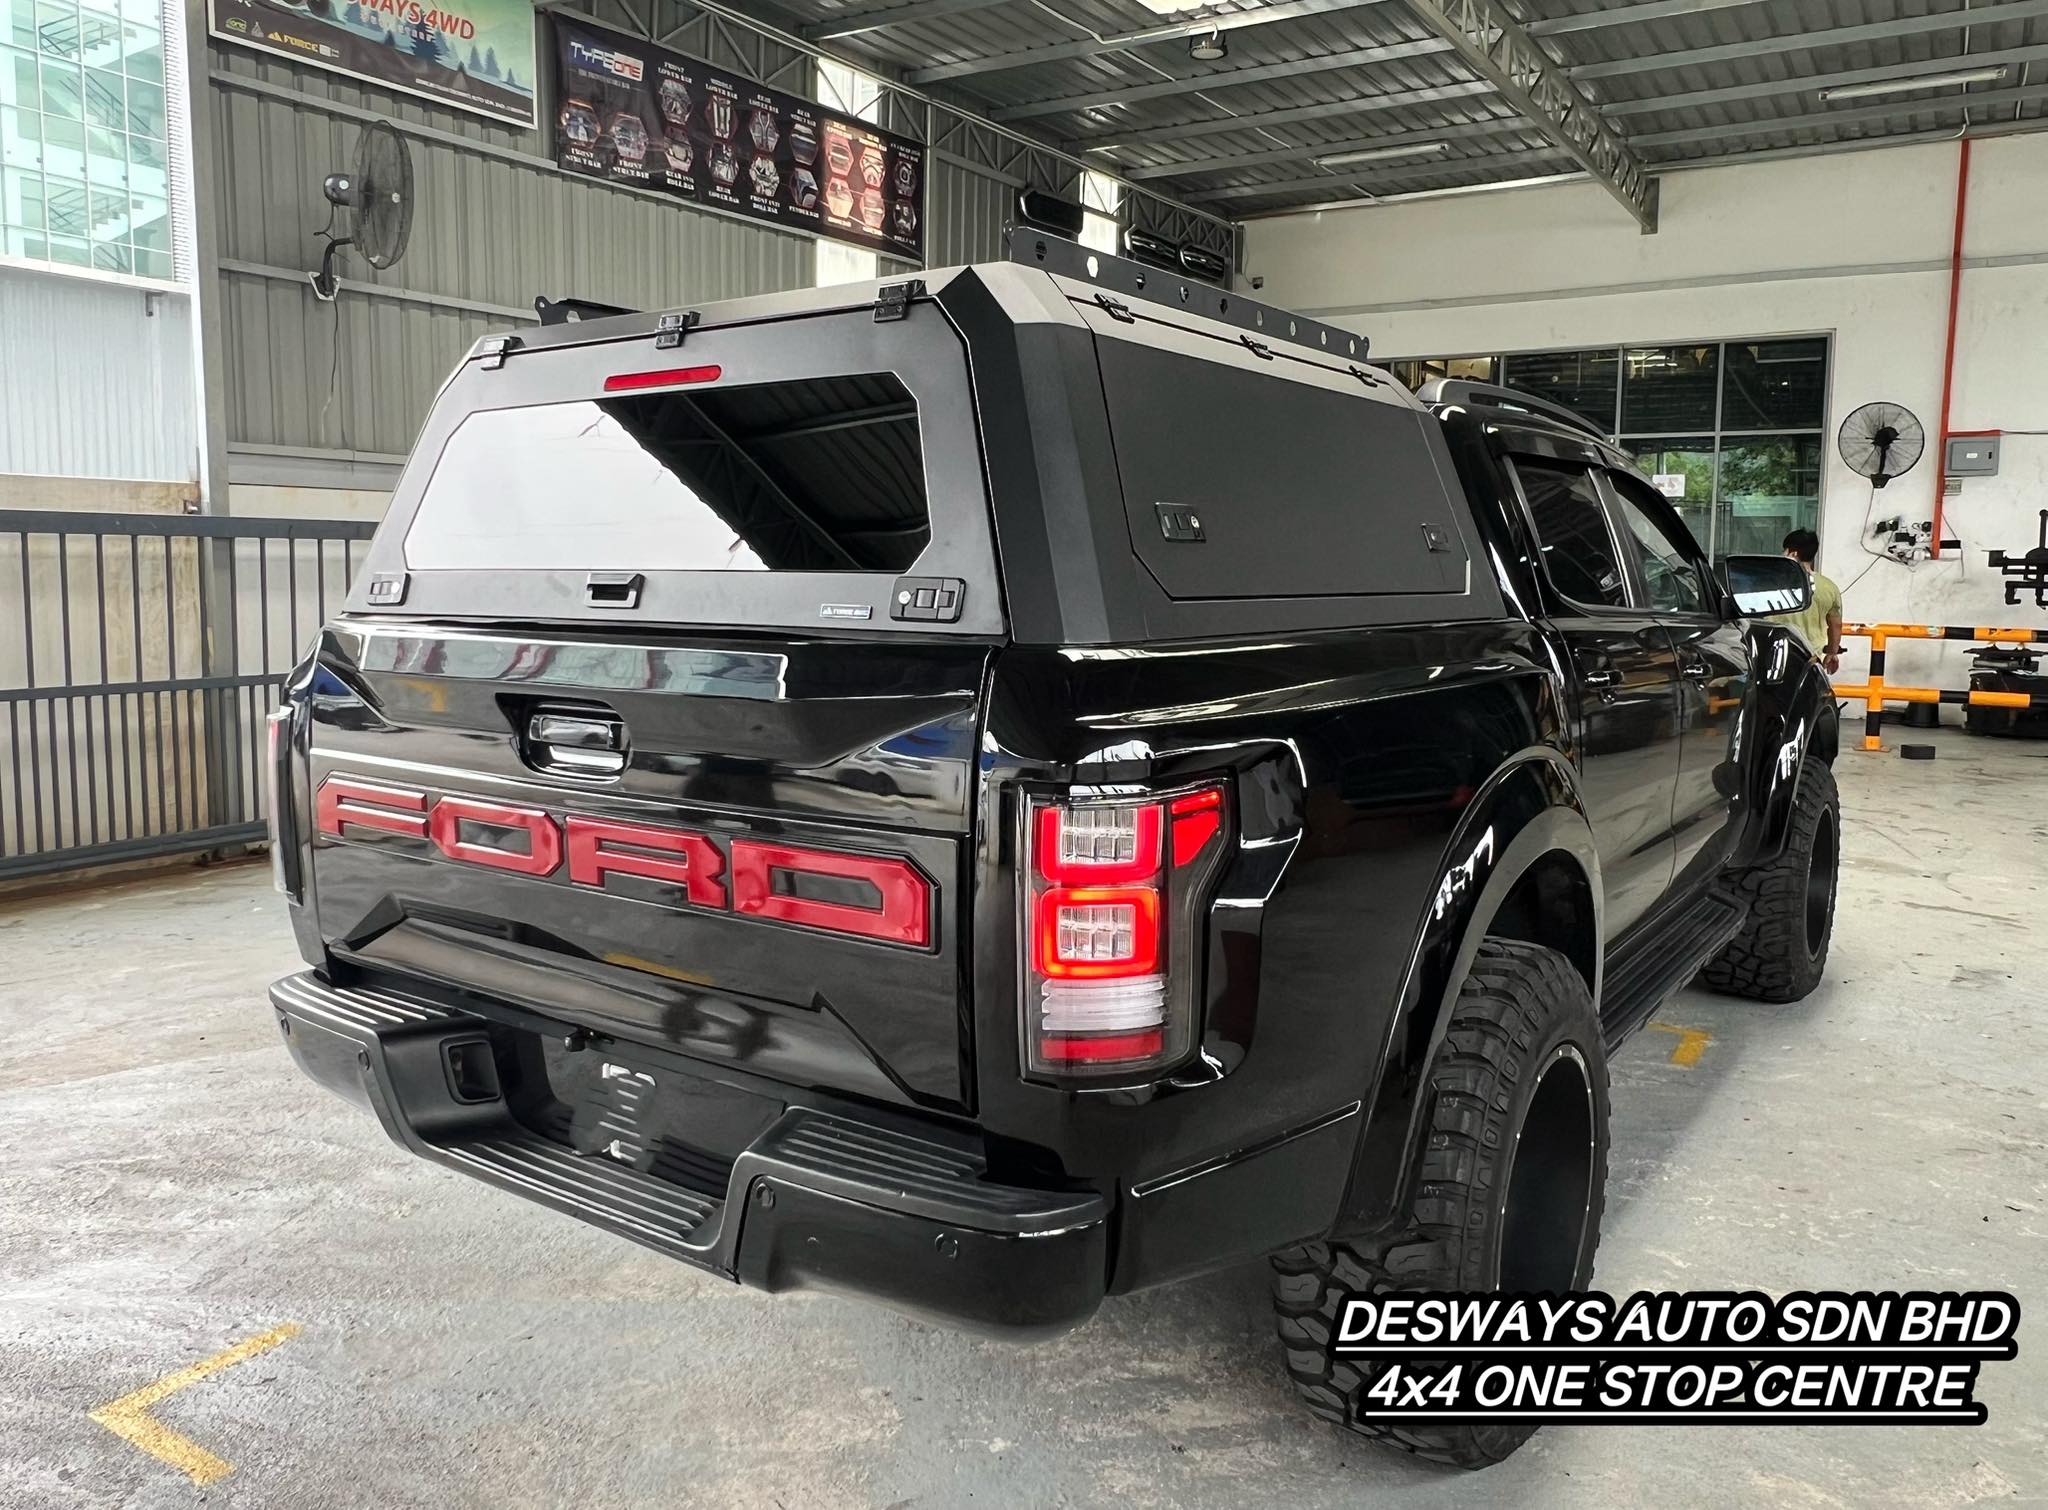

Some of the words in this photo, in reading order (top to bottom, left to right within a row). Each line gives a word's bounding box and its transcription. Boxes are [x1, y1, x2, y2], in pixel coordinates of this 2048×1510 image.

[426, 10, 475, 39] 4WD
[283, 34, 319, 52] FORCE
[317, 770, 932, 948] FORD
